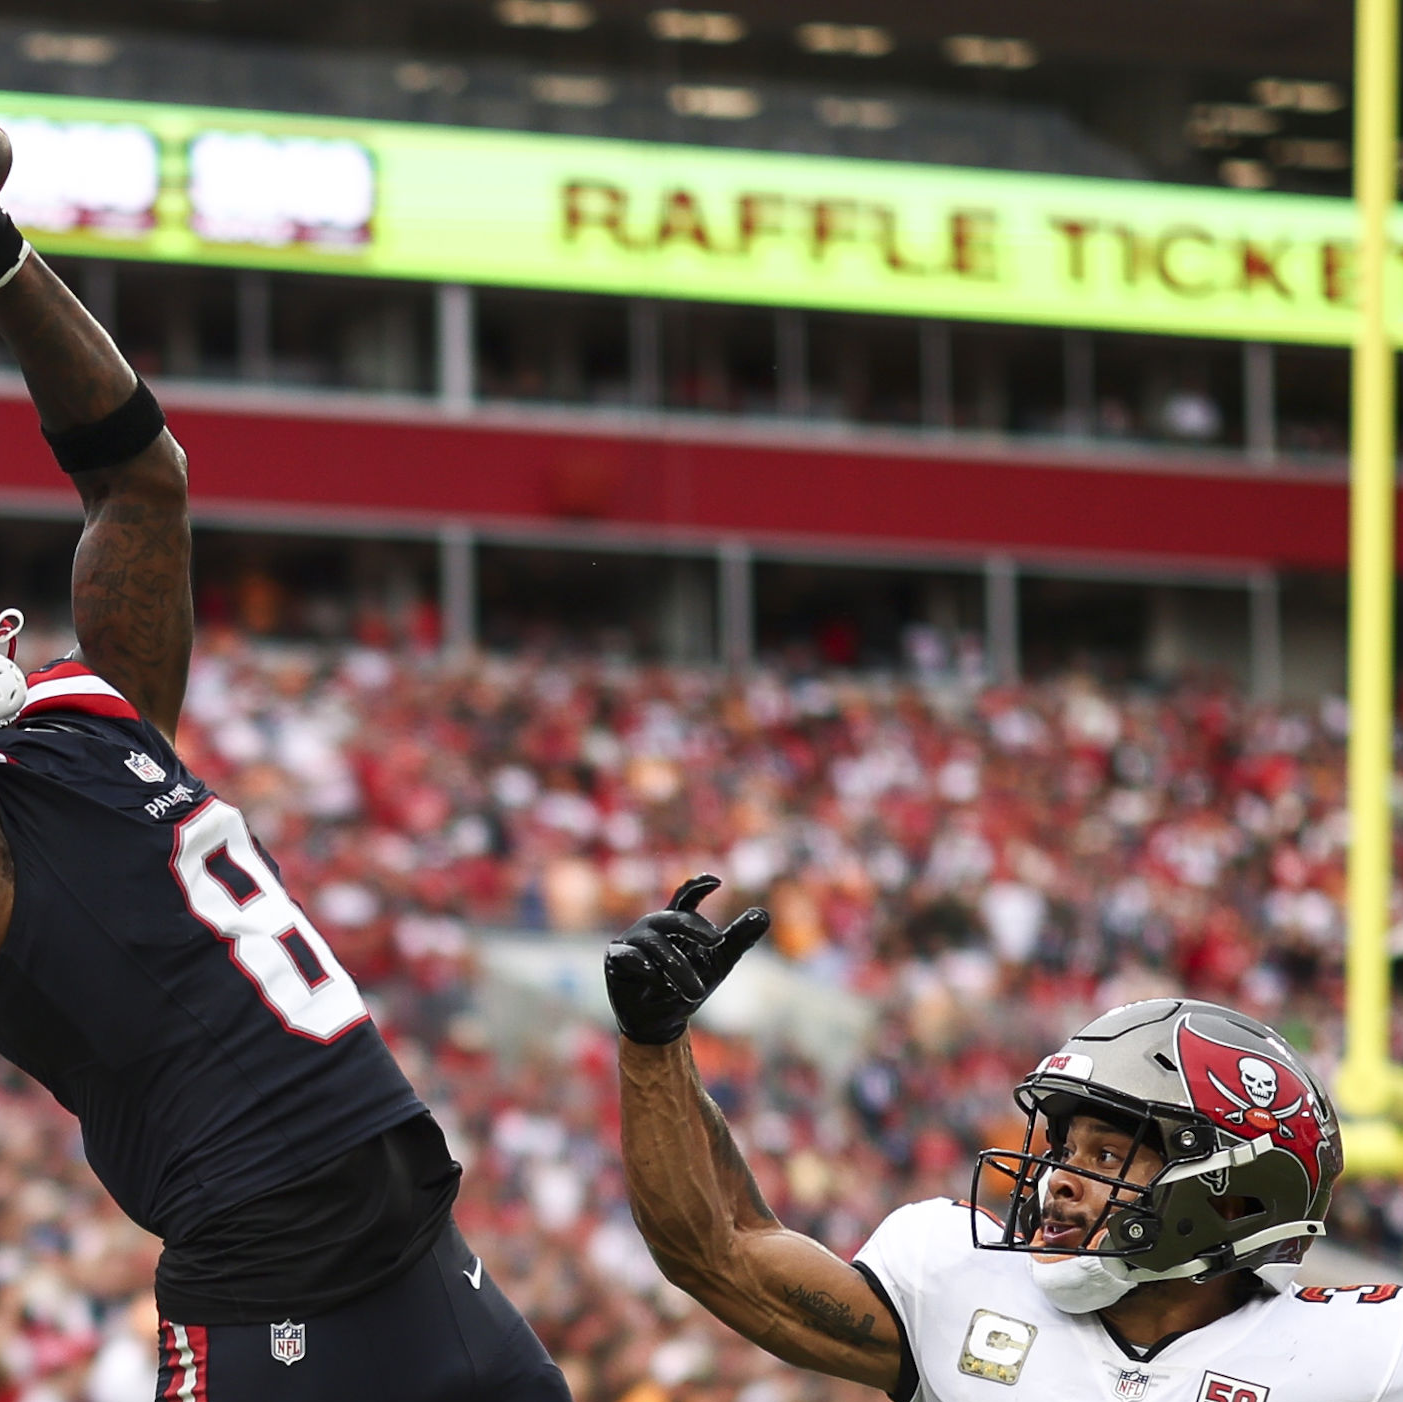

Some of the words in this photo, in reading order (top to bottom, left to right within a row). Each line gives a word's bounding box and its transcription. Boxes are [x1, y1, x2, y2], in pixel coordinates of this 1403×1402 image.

[560, 179, 1002, 283] RAFFLE
[169, 796, 371, 1045] 8
[277, 1340, 300, 1356] NFL
[967, 1314, 1032, 1367] C
[1118, 1380, 1142, 1398] NFL
